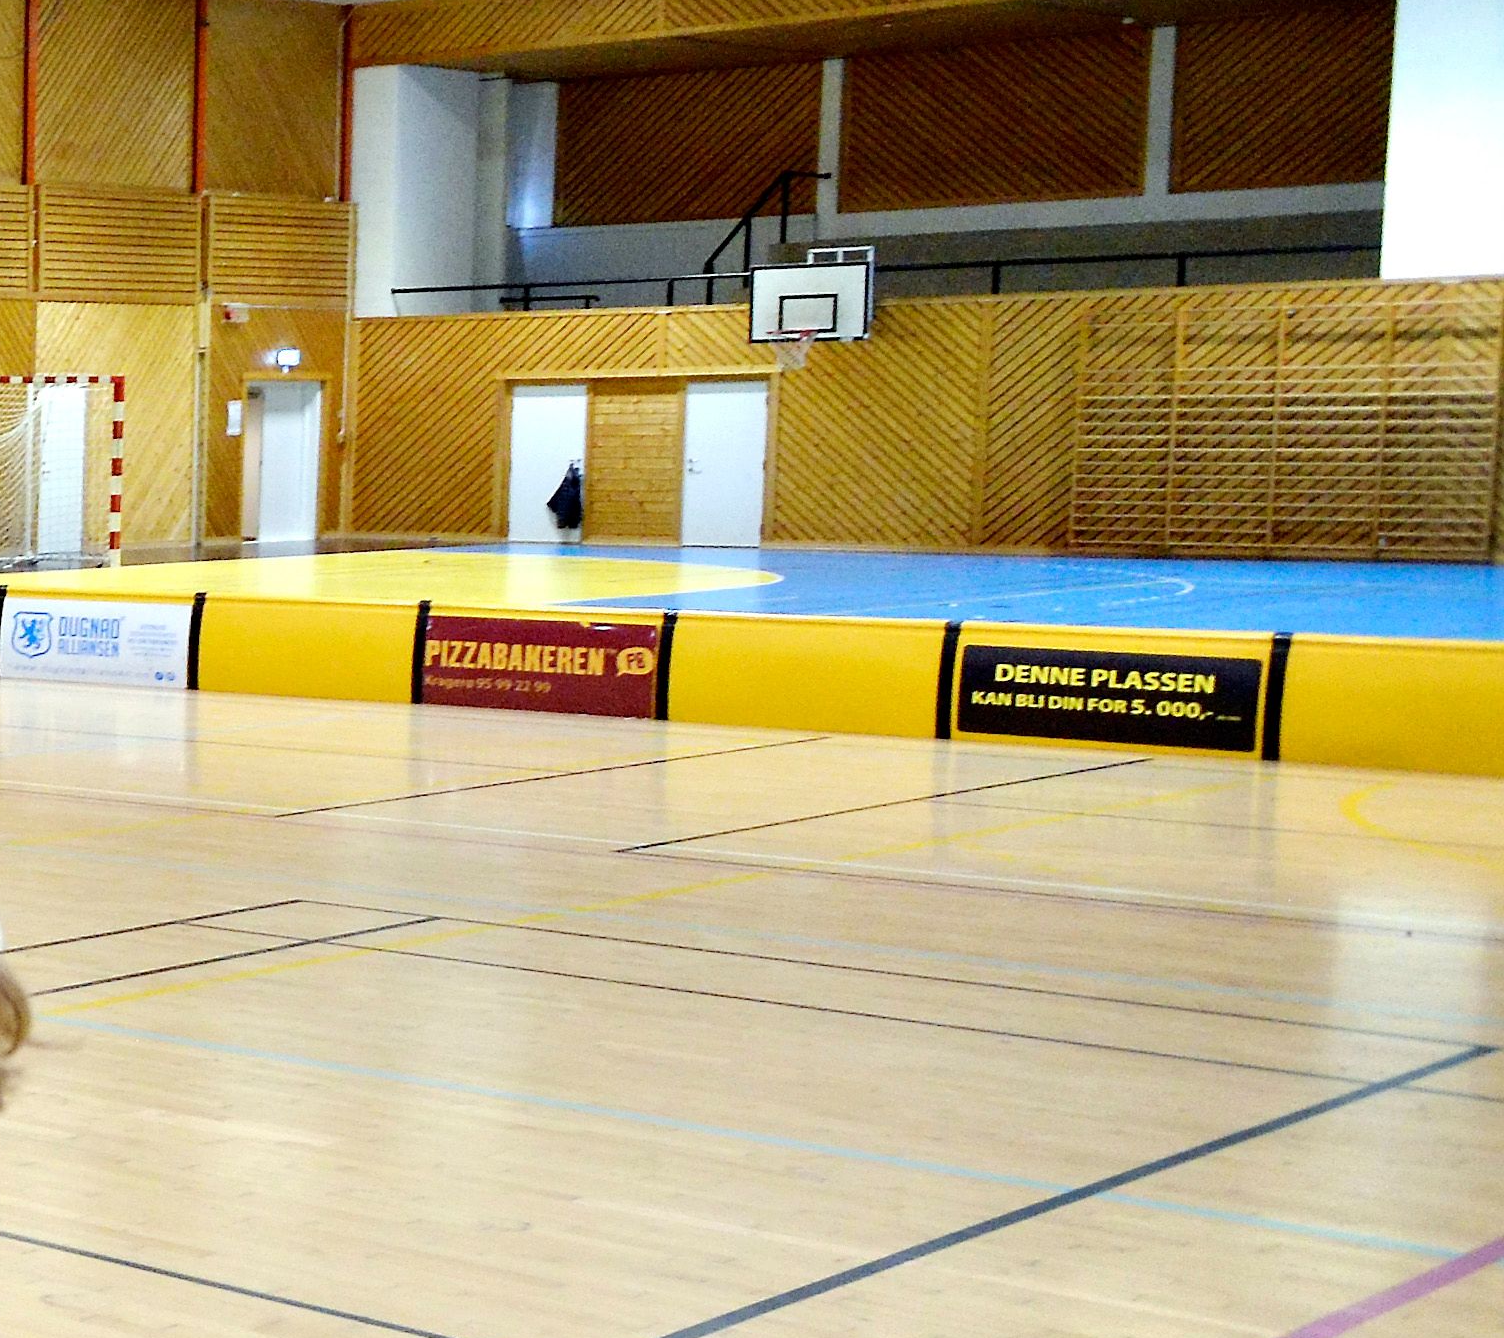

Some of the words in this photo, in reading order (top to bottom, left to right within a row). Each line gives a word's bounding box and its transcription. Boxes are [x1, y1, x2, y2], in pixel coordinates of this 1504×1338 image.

[58, 615, 120, 640] DUGNAD
[424, 639, 605, 676] PIZZABAKEREN
[994, 662, 1086, 687] DENNE
[1090, 667, 1217, 695] PLASSEN
[971, 691, 1012, 707] KAN
[1015, 693, 1044, 709] BLI
[1047, 695, 1084, 711] DIN
[1087, 697, 1127, 714] FOR
